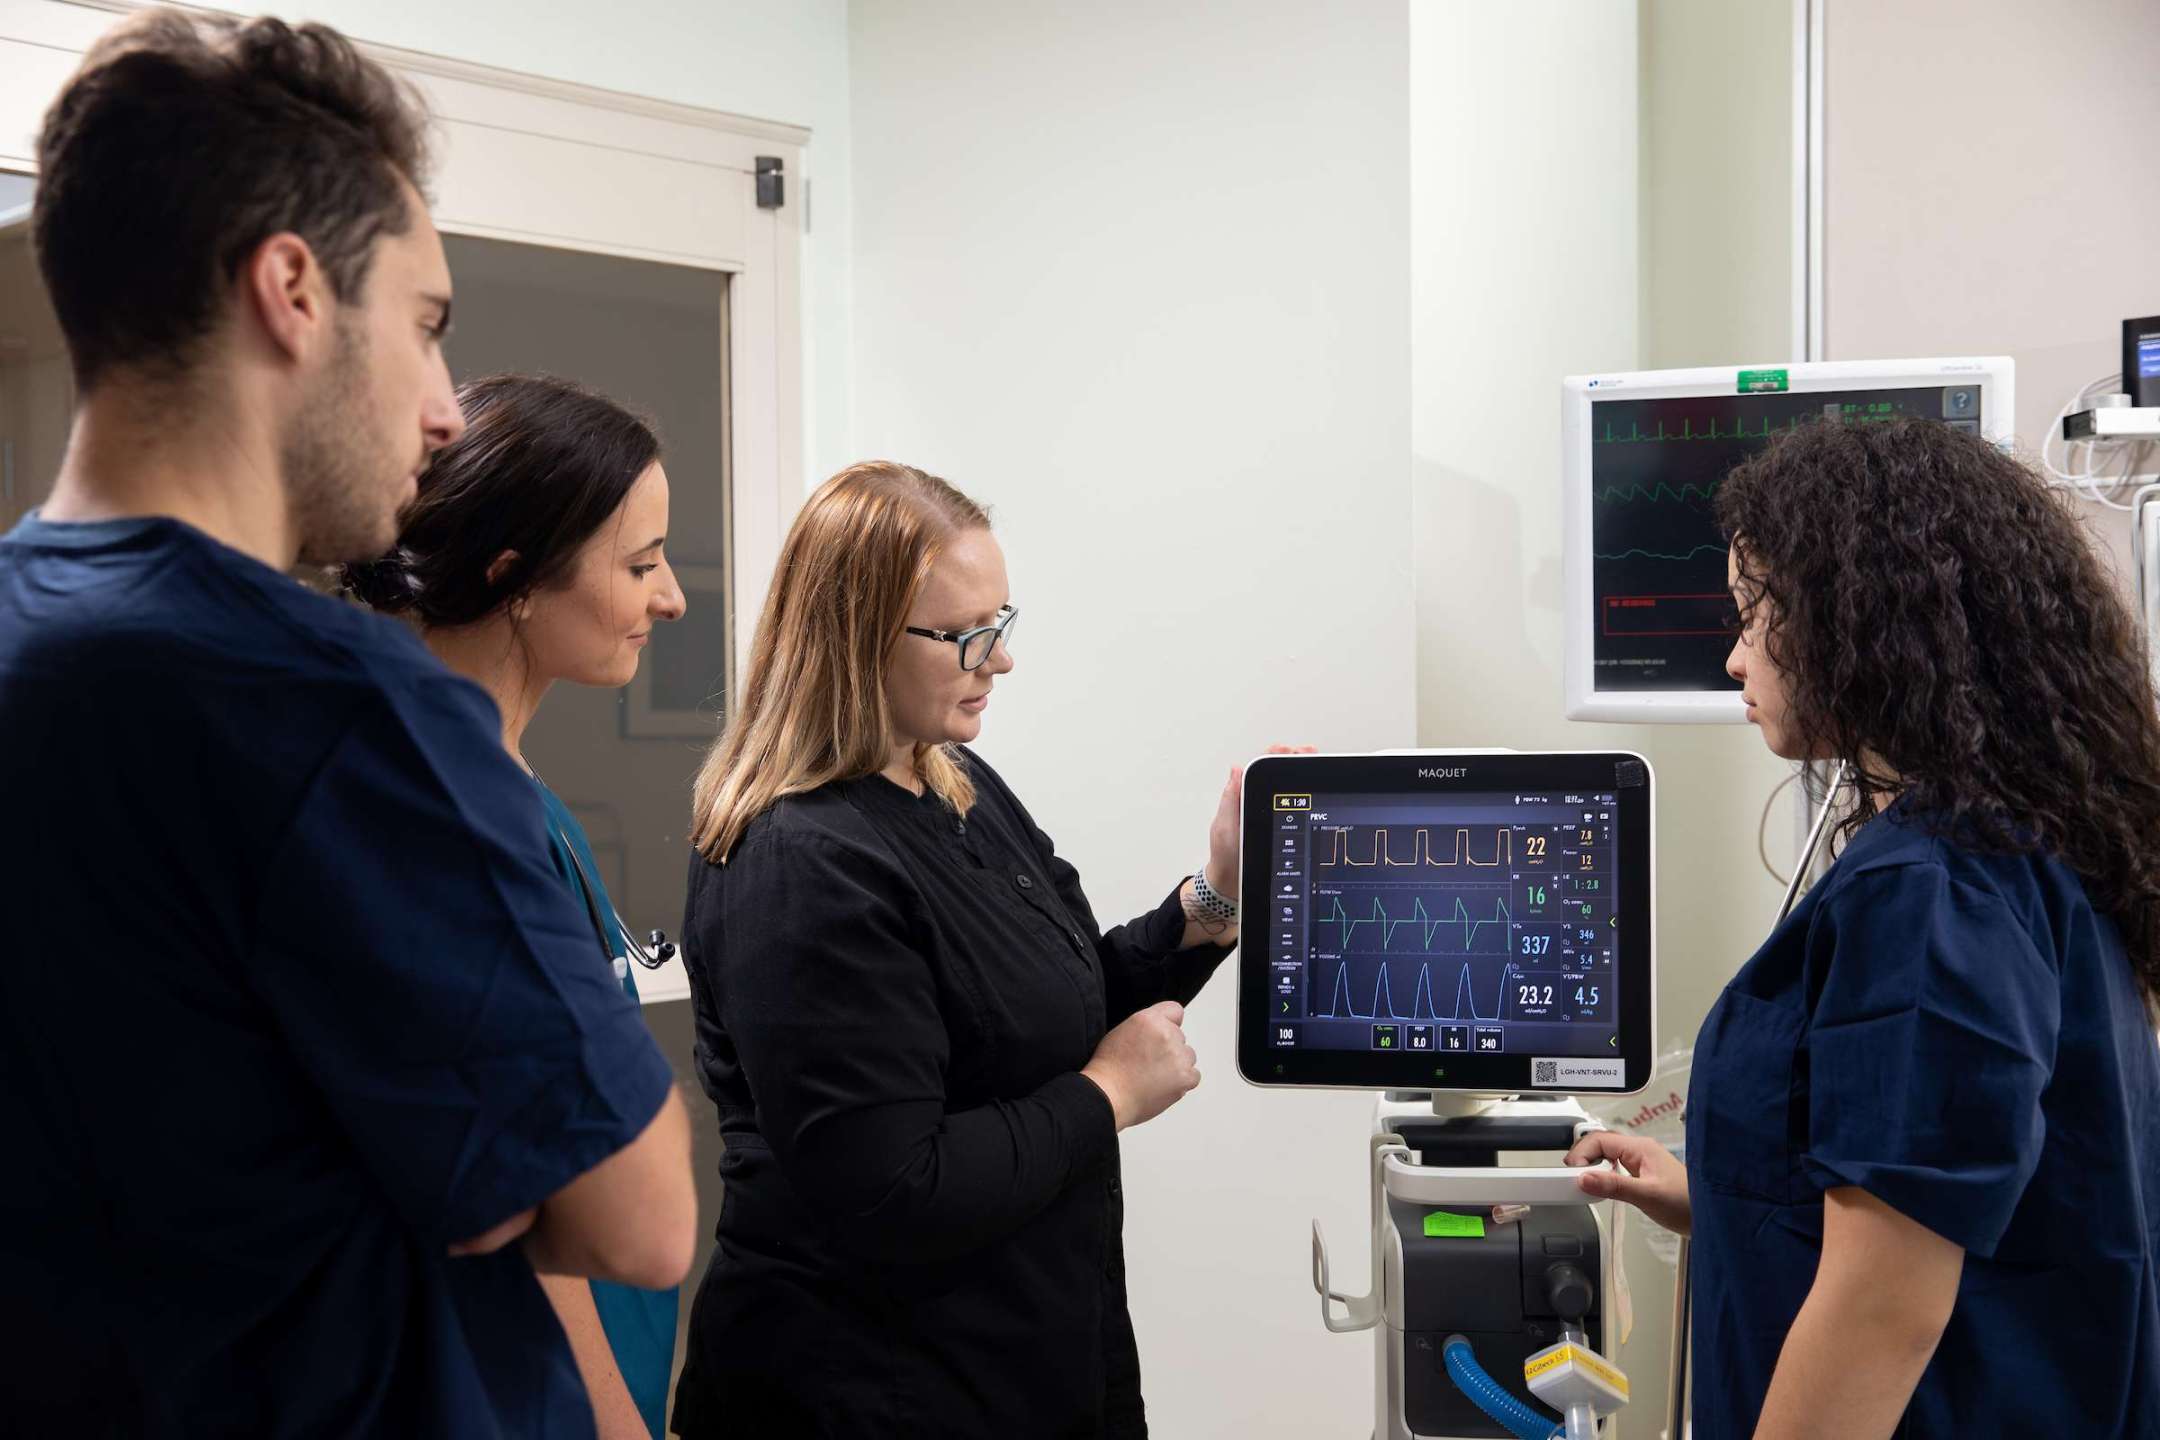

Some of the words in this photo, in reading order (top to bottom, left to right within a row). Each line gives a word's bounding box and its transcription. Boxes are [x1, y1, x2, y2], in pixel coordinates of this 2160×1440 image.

[1418, 768, 1467, 779] MAQUET
[1310, 813, 1328, 821] PRVC
[1580, 830, 1592, 840] 7.8
[1527, 837, 1545, 855] 22
[1582, 855, 1592, 864] 12
[1586, 880, 1599, 889] 2.8
[1528, 886, 1545, 904] 16
[1582, 905, 1592, 914] 60
[1580, 929, 1594, 939] 346
[1522, 936, 1550, 954] 337
[1580, 955, 1593, 964] 5.4
[1519, 986, 1553, 1005] 23.2
[1575, 987, 1599, 1005] 4.5
[1279, 1028, 1293, 1040] 100
[1380, 1036, 1391, 1047] 60
[1413, 1037, 1426, 1048] 8.0
[1449, 1038, 1459, 1048] 16
[1481, 1038, 1496, 1049] 340
